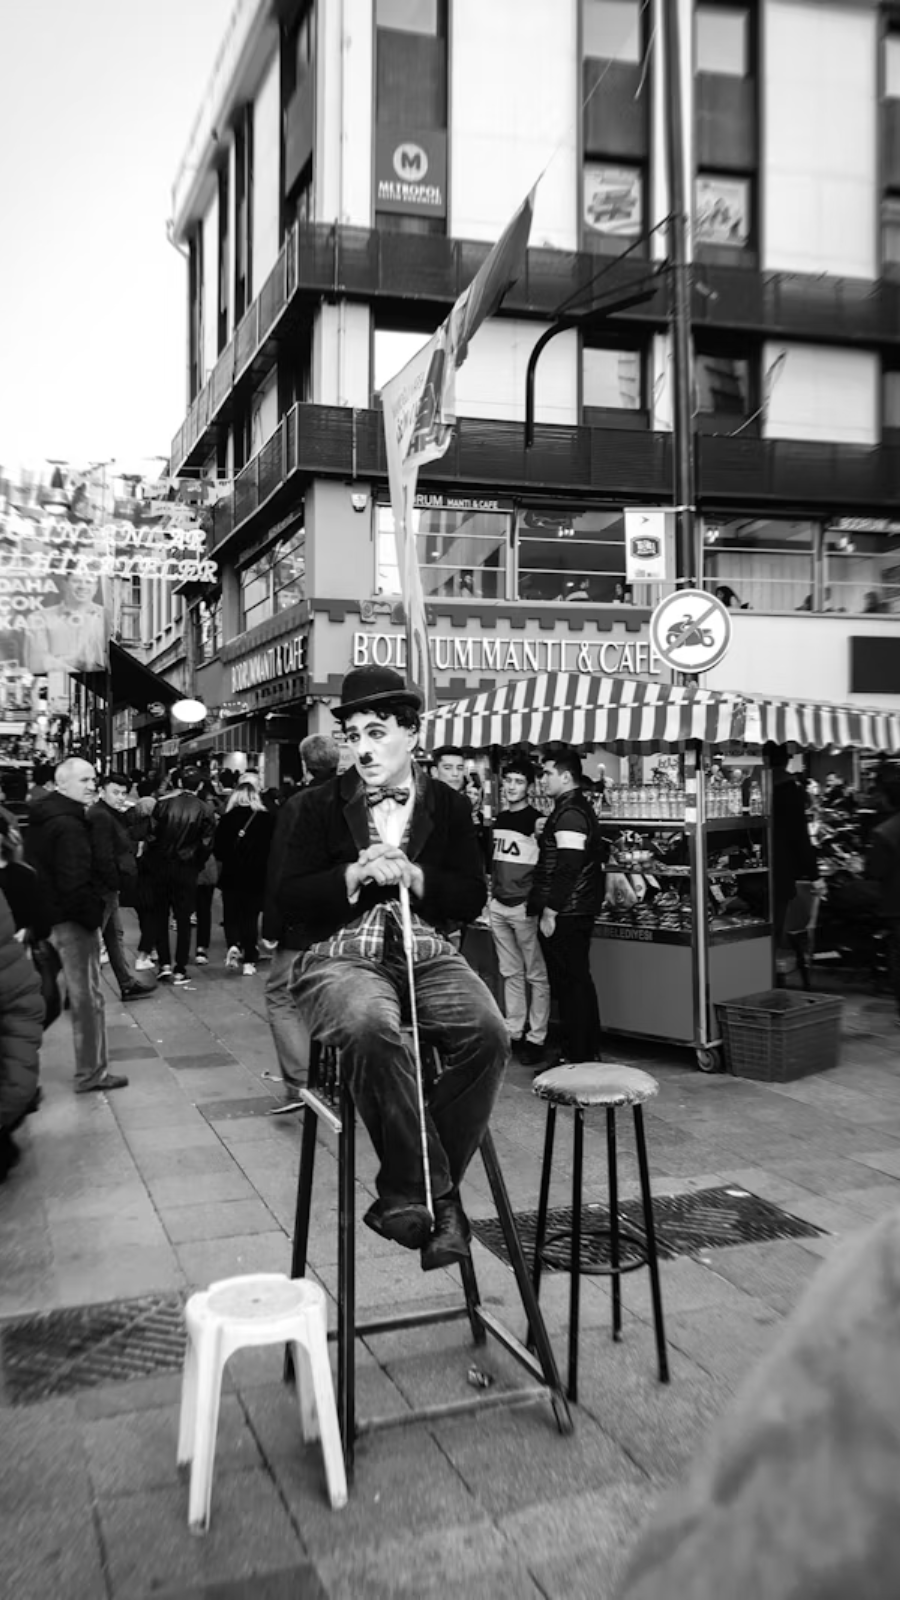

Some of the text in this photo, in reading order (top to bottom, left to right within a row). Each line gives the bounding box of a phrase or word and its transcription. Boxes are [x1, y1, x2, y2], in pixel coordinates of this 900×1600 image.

[401, 151, 421, 170] M
[379, 181, 441, 199] METROPOL
[414, 494, 443, 506] RUM
[447, 498, 471, 508] MANTI
[480, 500, 498, 509] CAFE
[482, 638, 567, 672] MANTI
[577, 641, 593, 672] &
[599, 641, 662, 674] CAFE
[494, 838, 520, 857] FILA
